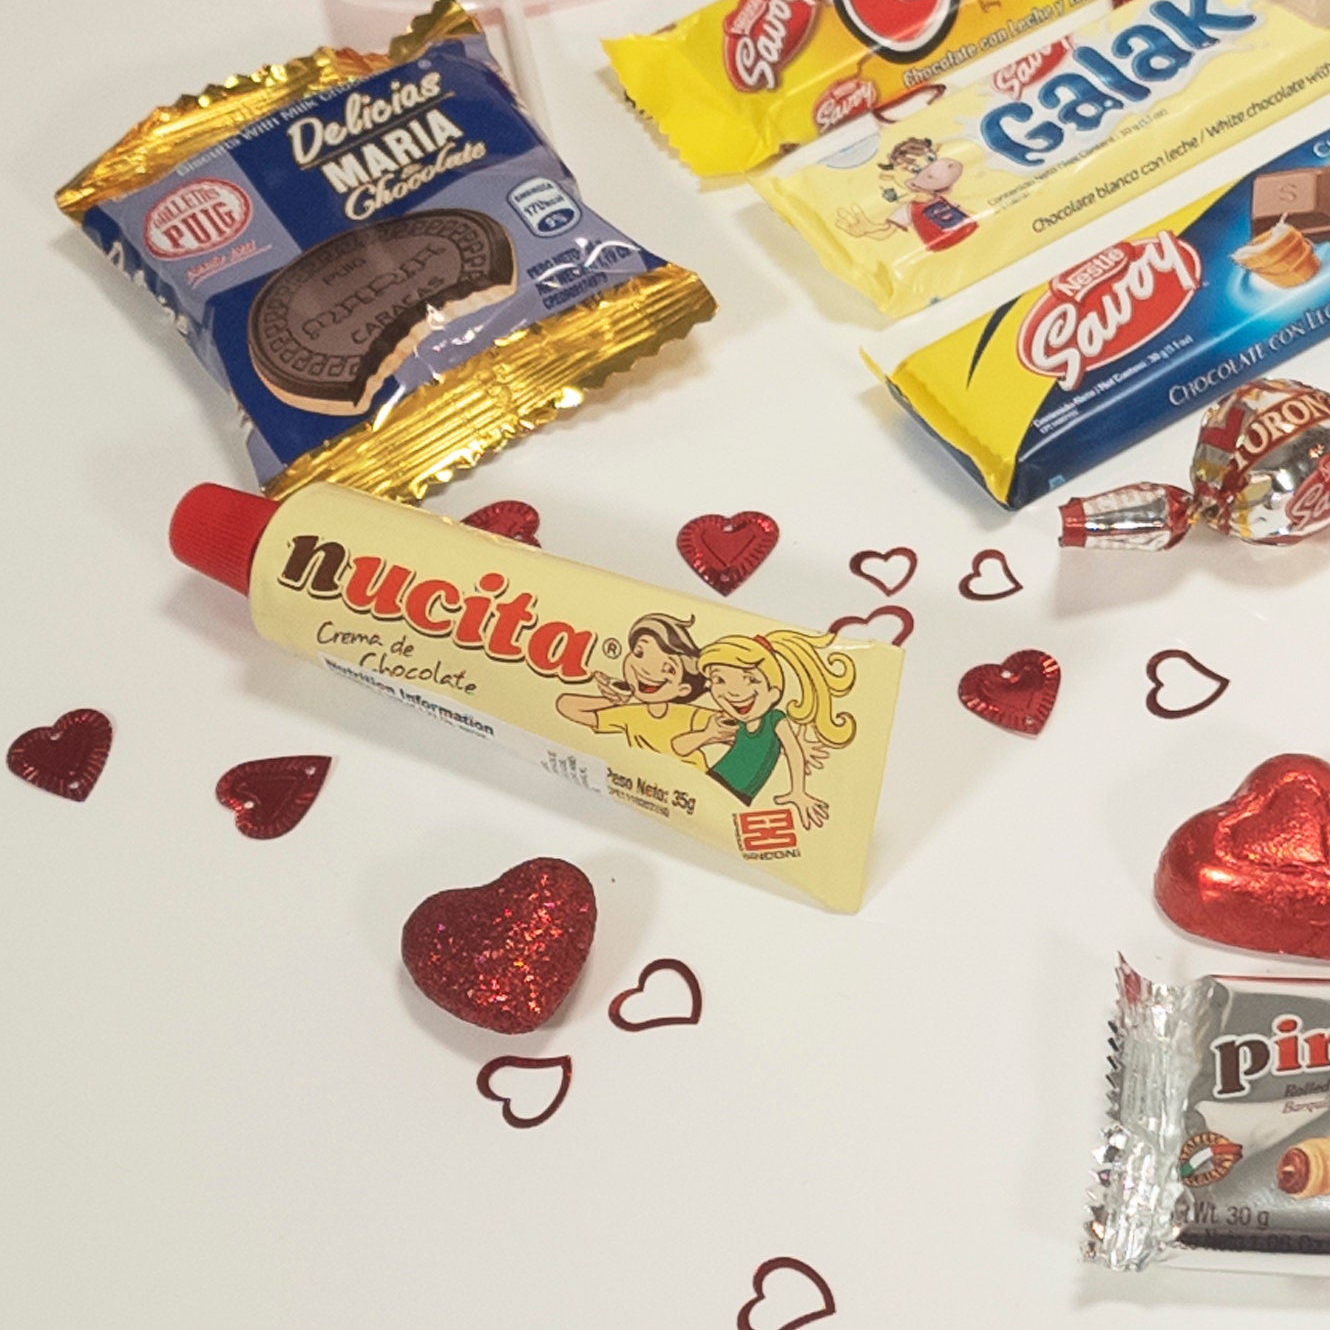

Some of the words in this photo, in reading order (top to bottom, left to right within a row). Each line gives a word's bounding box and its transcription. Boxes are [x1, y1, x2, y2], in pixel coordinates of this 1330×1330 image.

[903, 42, 978, 88] Chocolate
[980, 27, 1008, 54] con
[242, 112, 281, 144] With
[280, 99, 320, 125] Milk
[286, 72, 444, 164] Delicias
[322, 109, 464, 196] MARIA
[344, 141, 487, 221] Chocolate
[1031, 192, 1095, 234] Chocolate
[1095, 168, 1140, 199] blanco
[1139, 155, 1165, 177] con
[1165, 135, 1199, 165] leche
[1206, 111, 1246, 140] White
[1246, 77, 1307, 120] chocolate
[162, 201, 236, 250] PUIG
[1030, 230, 1198, 391] Savoy
[1167, 337, 1267, 407] CHOCOLATE
[1267, 319, 1304, 352] CON
[279, 535, 596, 682] nucita
[316, 620, 384, 646] Crema
[389, 635, 416, 658] de
[358, 652, 478, 696] Chocolate
[398, 687, 496, 737] Information
[671, 789, 697, 815] 35g
[1226, 1206, 1252, 1226] 30
[1257, 1210, 1271, 1231] g
